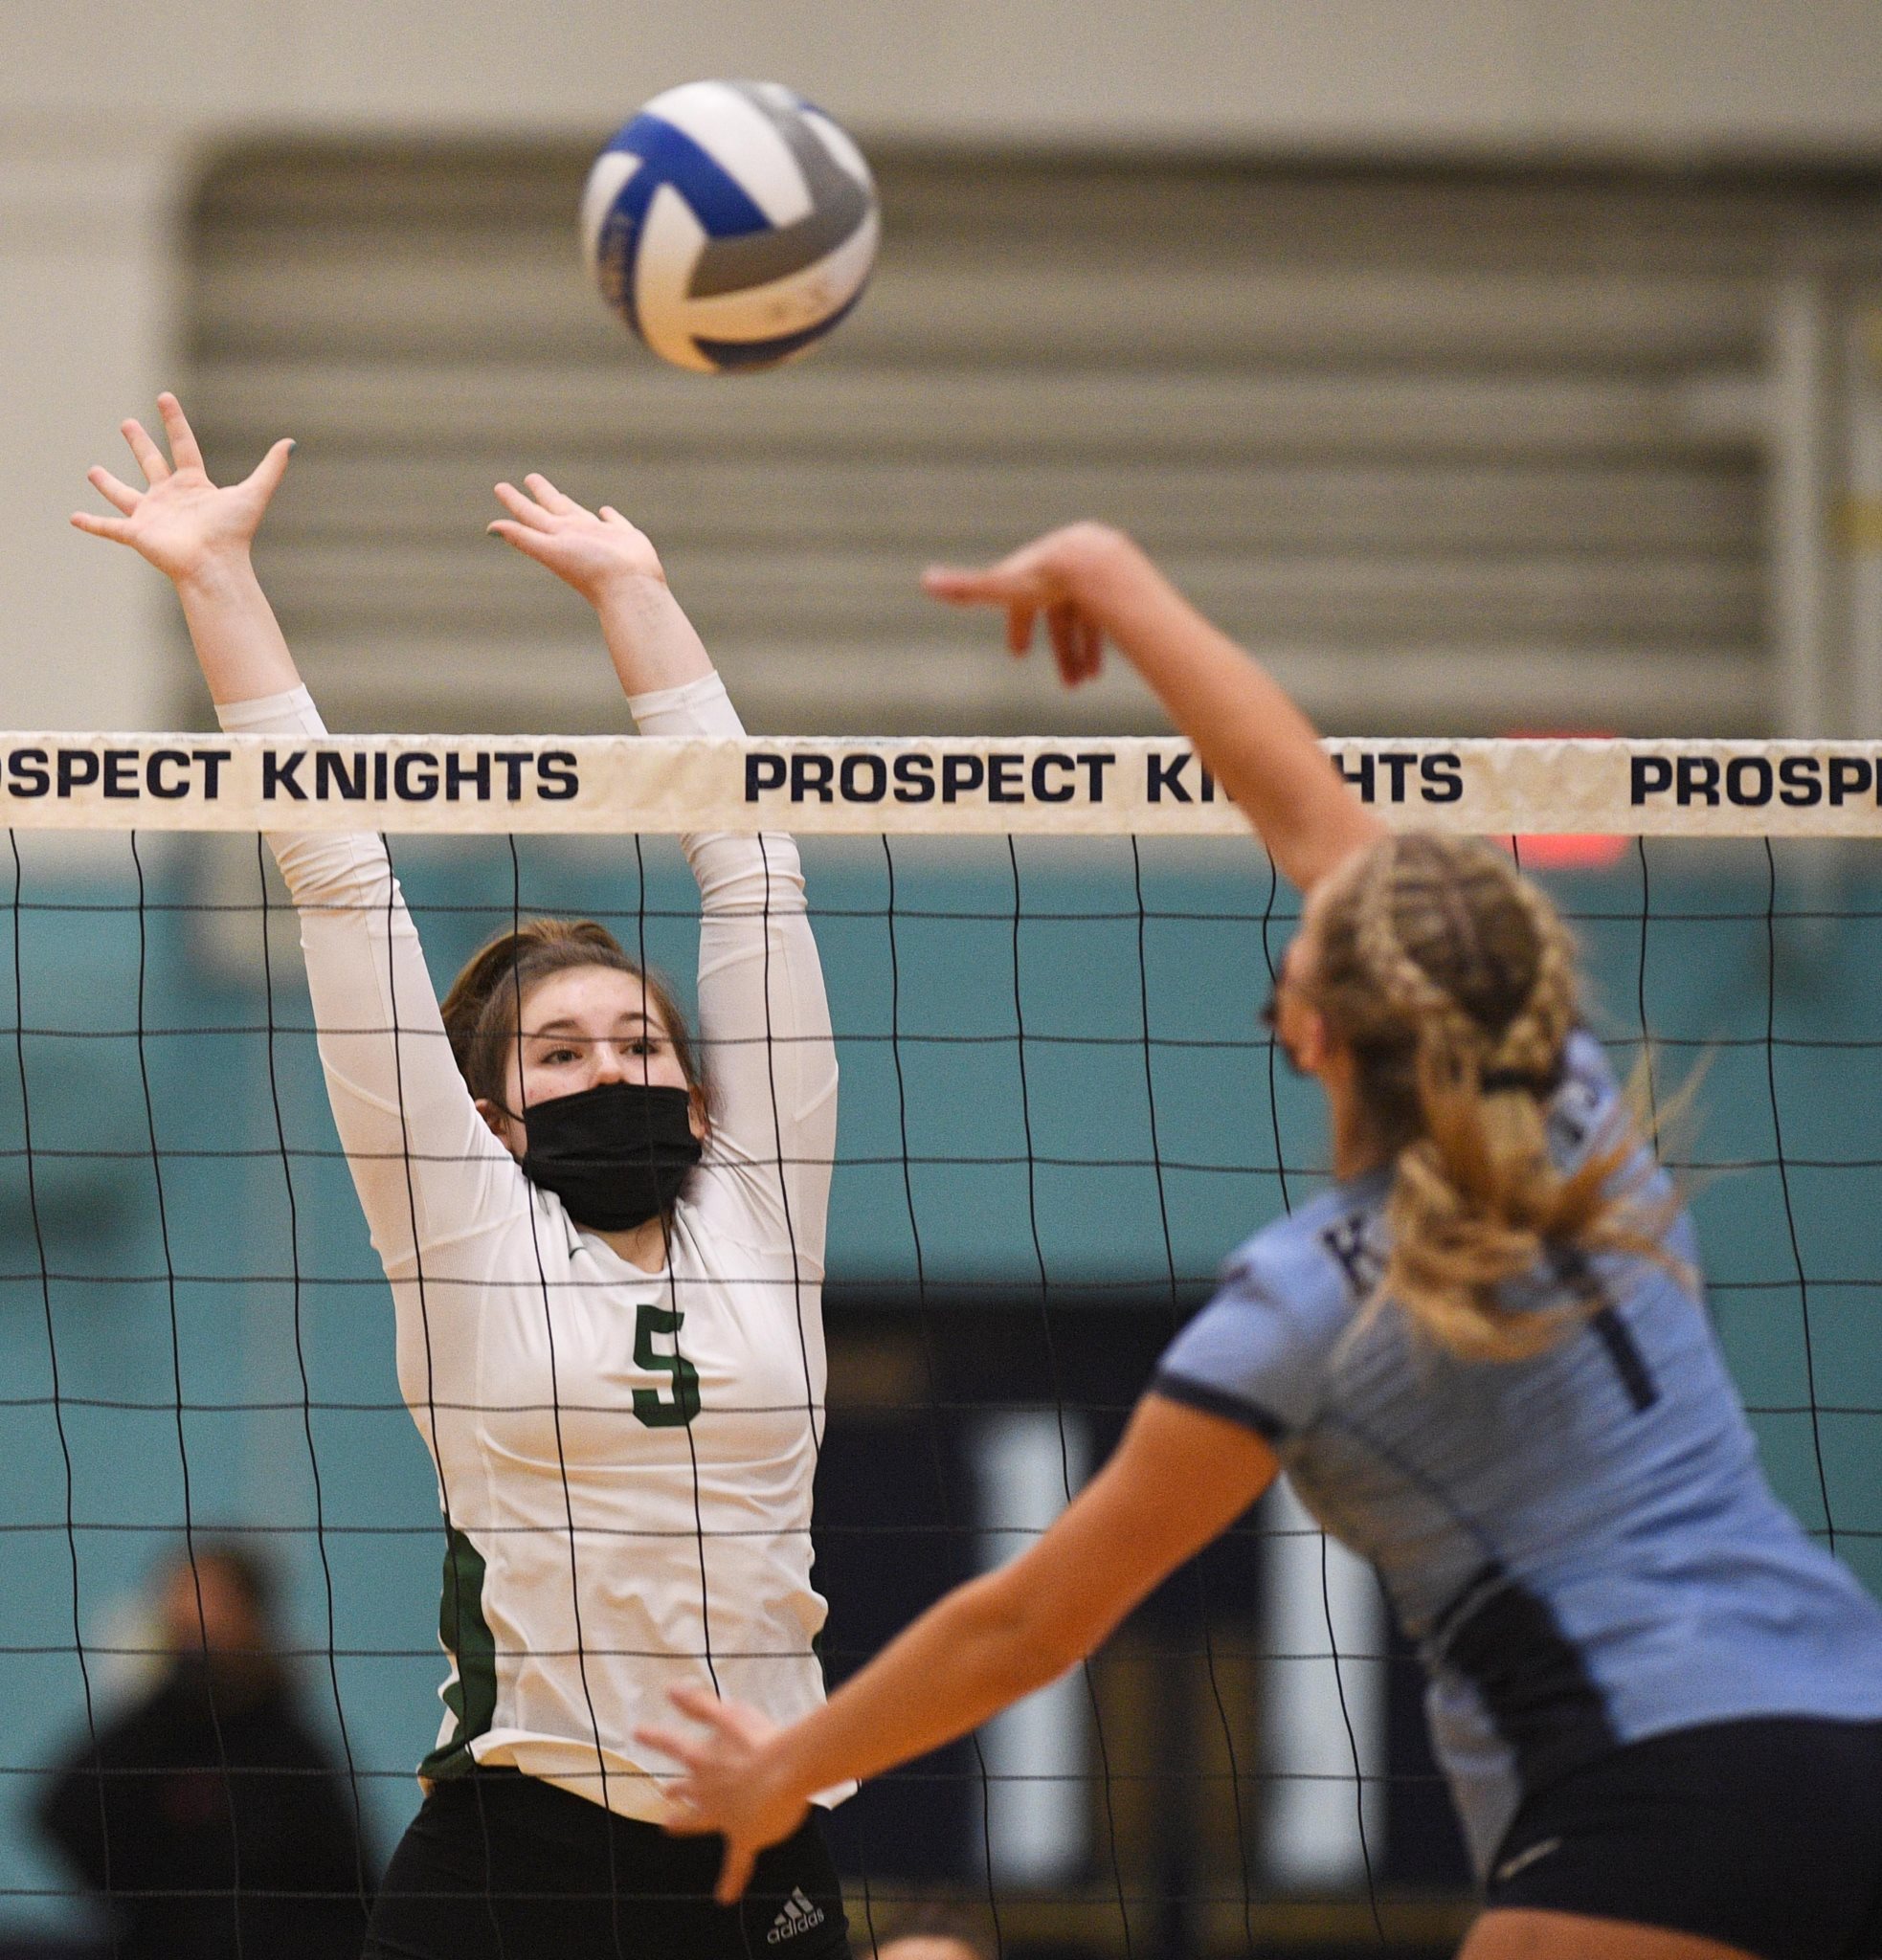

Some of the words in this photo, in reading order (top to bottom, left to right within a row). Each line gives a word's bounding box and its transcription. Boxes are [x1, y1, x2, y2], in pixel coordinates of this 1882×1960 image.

[0, 749, 232, 800] SPECT
[262, 751, 580, 802] KNIGHTS
[745, 753, 1116, 804] PROSPECT
[1147, 752, 1464, 804] KHTS
[1630, 756, 1882, 807] PROSP
[631, 1303, 702, 1429] 5
[767, 1907, 825, 1945] adidas
